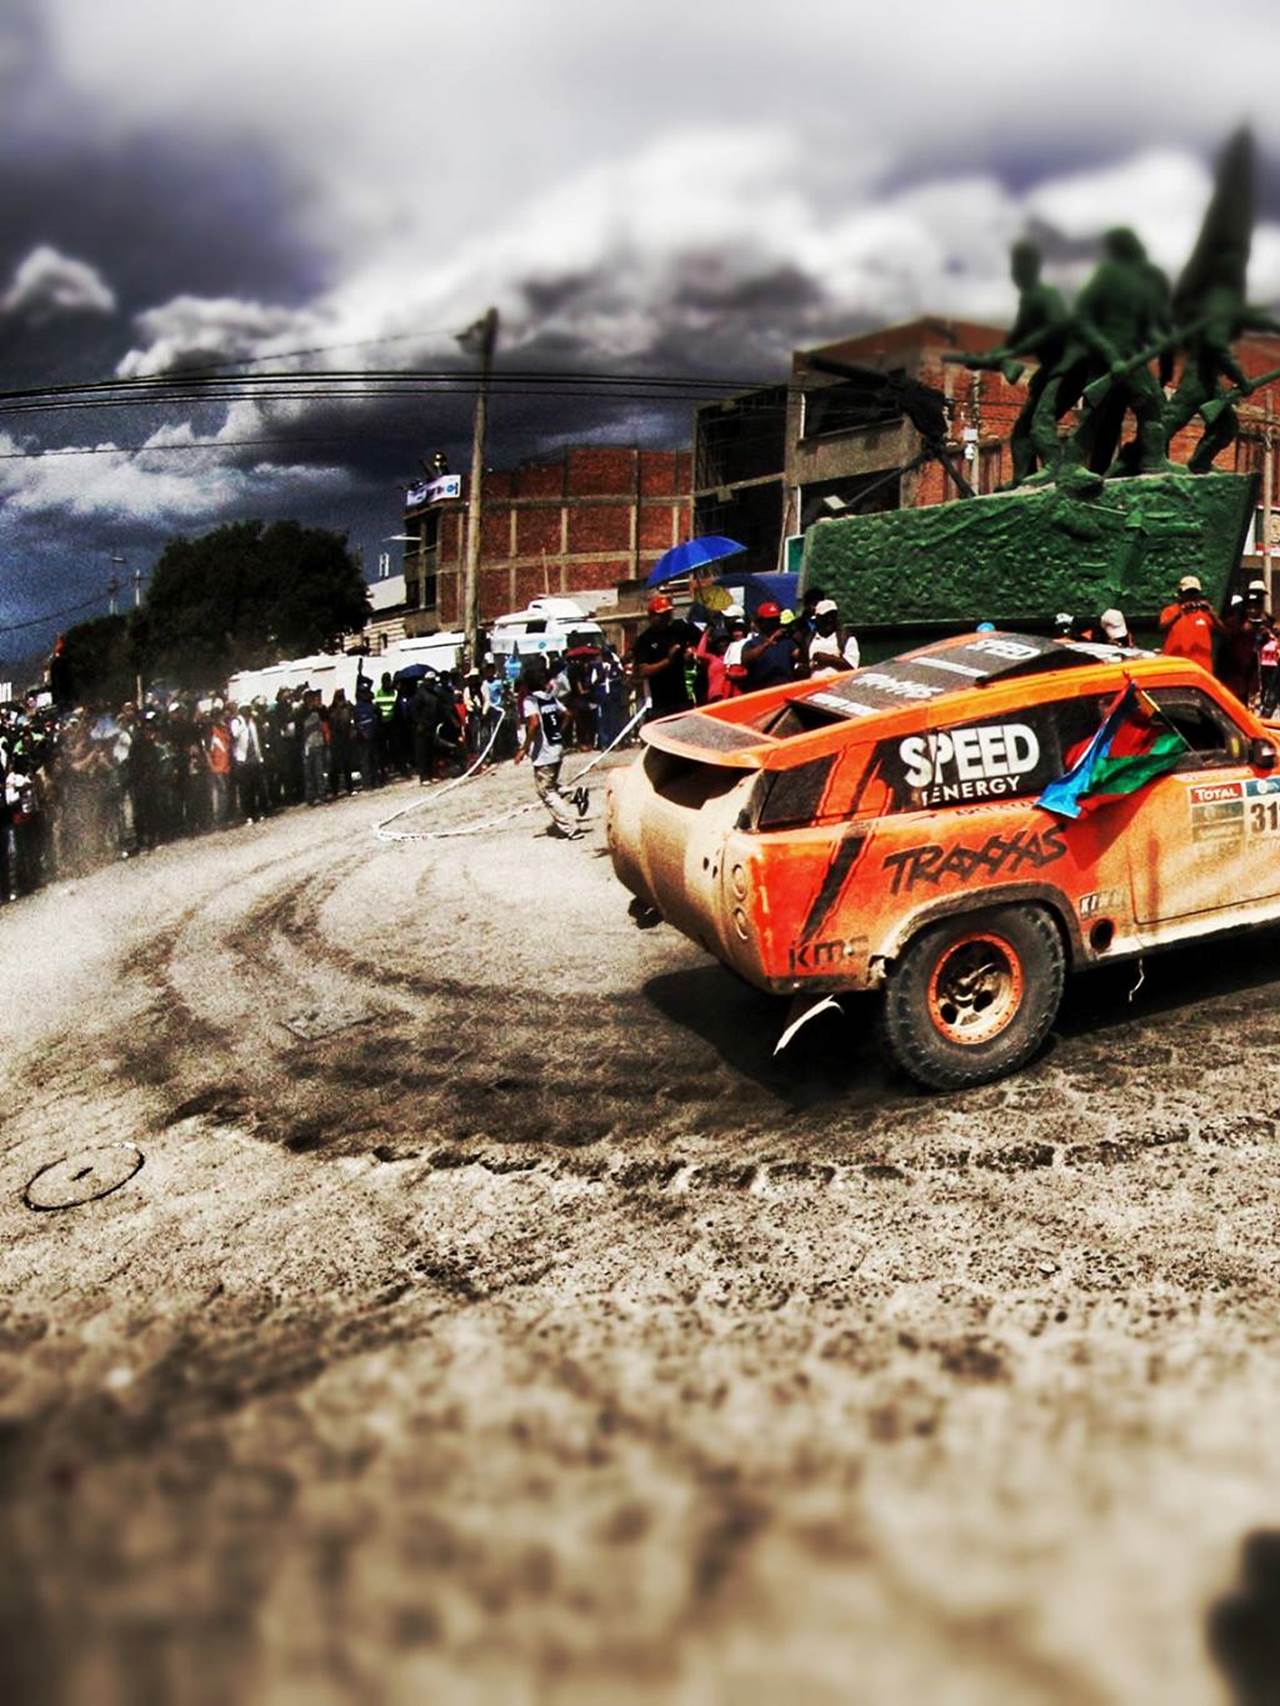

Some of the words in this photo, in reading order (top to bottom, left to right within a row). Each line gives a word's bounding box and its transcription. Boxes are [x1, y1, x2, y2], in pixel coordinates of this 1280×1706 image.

[899, 723, 1040, 788] SPEED
[922, 776, 1021, 806] ENERGY
[1194, 786, 1239, 801] TOTAL
[881, 824, 1068, 896] TRAXXAS
